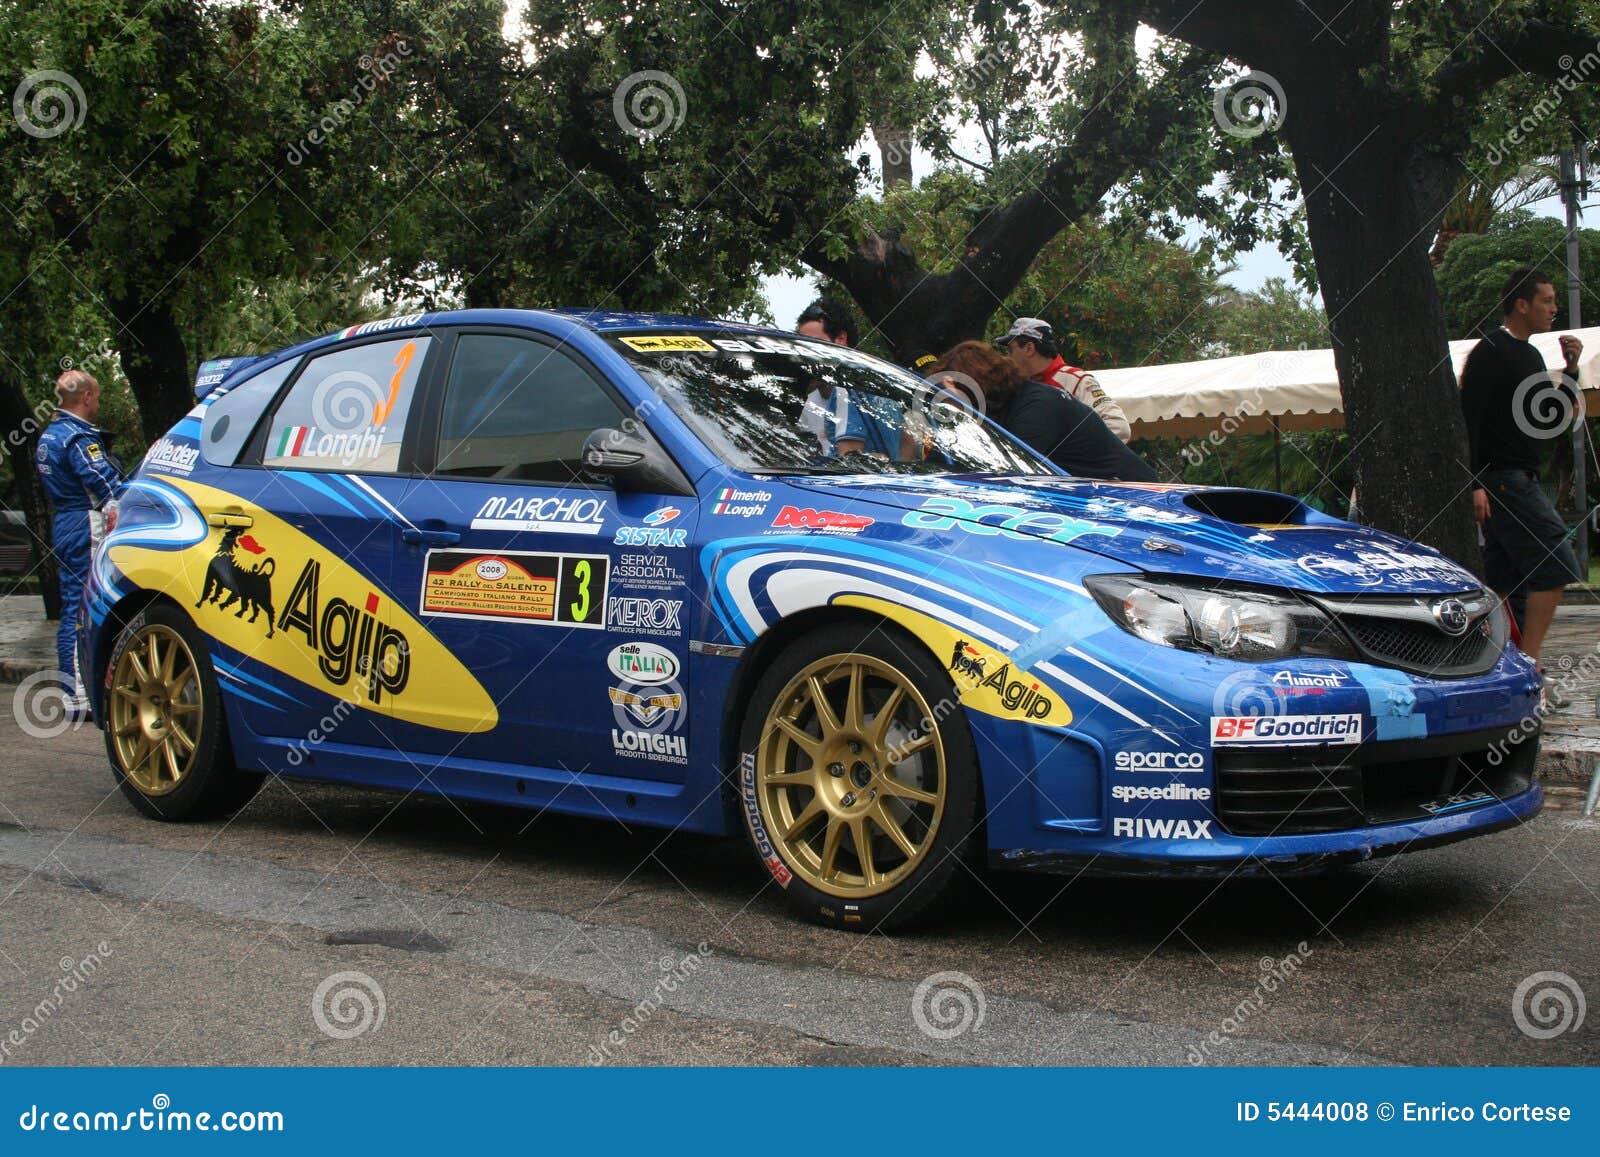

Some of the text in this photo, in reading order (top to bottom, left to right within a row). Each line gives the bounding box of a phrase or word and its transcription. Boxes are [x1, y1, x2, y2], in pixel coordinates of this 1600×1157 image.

[302, 426, 386, 466] Longhi
[731, 489, 772, 501] Imerito
[475, 497, 607, 522] MARCHIOL
[724, 504, 766, 517] Longhi
[901, 496, 1124, 547] acer
[613, 526, 688, 548] SISTAR
[481, 566, 501, 574] 2008
[621, 554, 667, 567] SERVIZI
[612, 566, 676, 579] ASSOCIATI
[450, 580, 481, 588] RALLY
[496, 582, 547, 592] SALENTO
[571, 559, 591, 622] 3
[608, 597, 683, 629] KEROX
[277, 558, 411, 705] Agip
[620, 645, 640, 654] selle
[620, 655, 667, 674] ITALIA
[982, 663, 1052, 719] Agip
[1215, 716, 1359, 738] BFGoodrich
[616, 749, 688, 765] PRODOTTI SIDERURGICI
[1115, 751, 1204, 773] sparco
[1112, 783, 1211, 803] speedline
[742, 753, 791, 885] BFGoodrich
[1113, 817, 1213, 839] RIWAX
